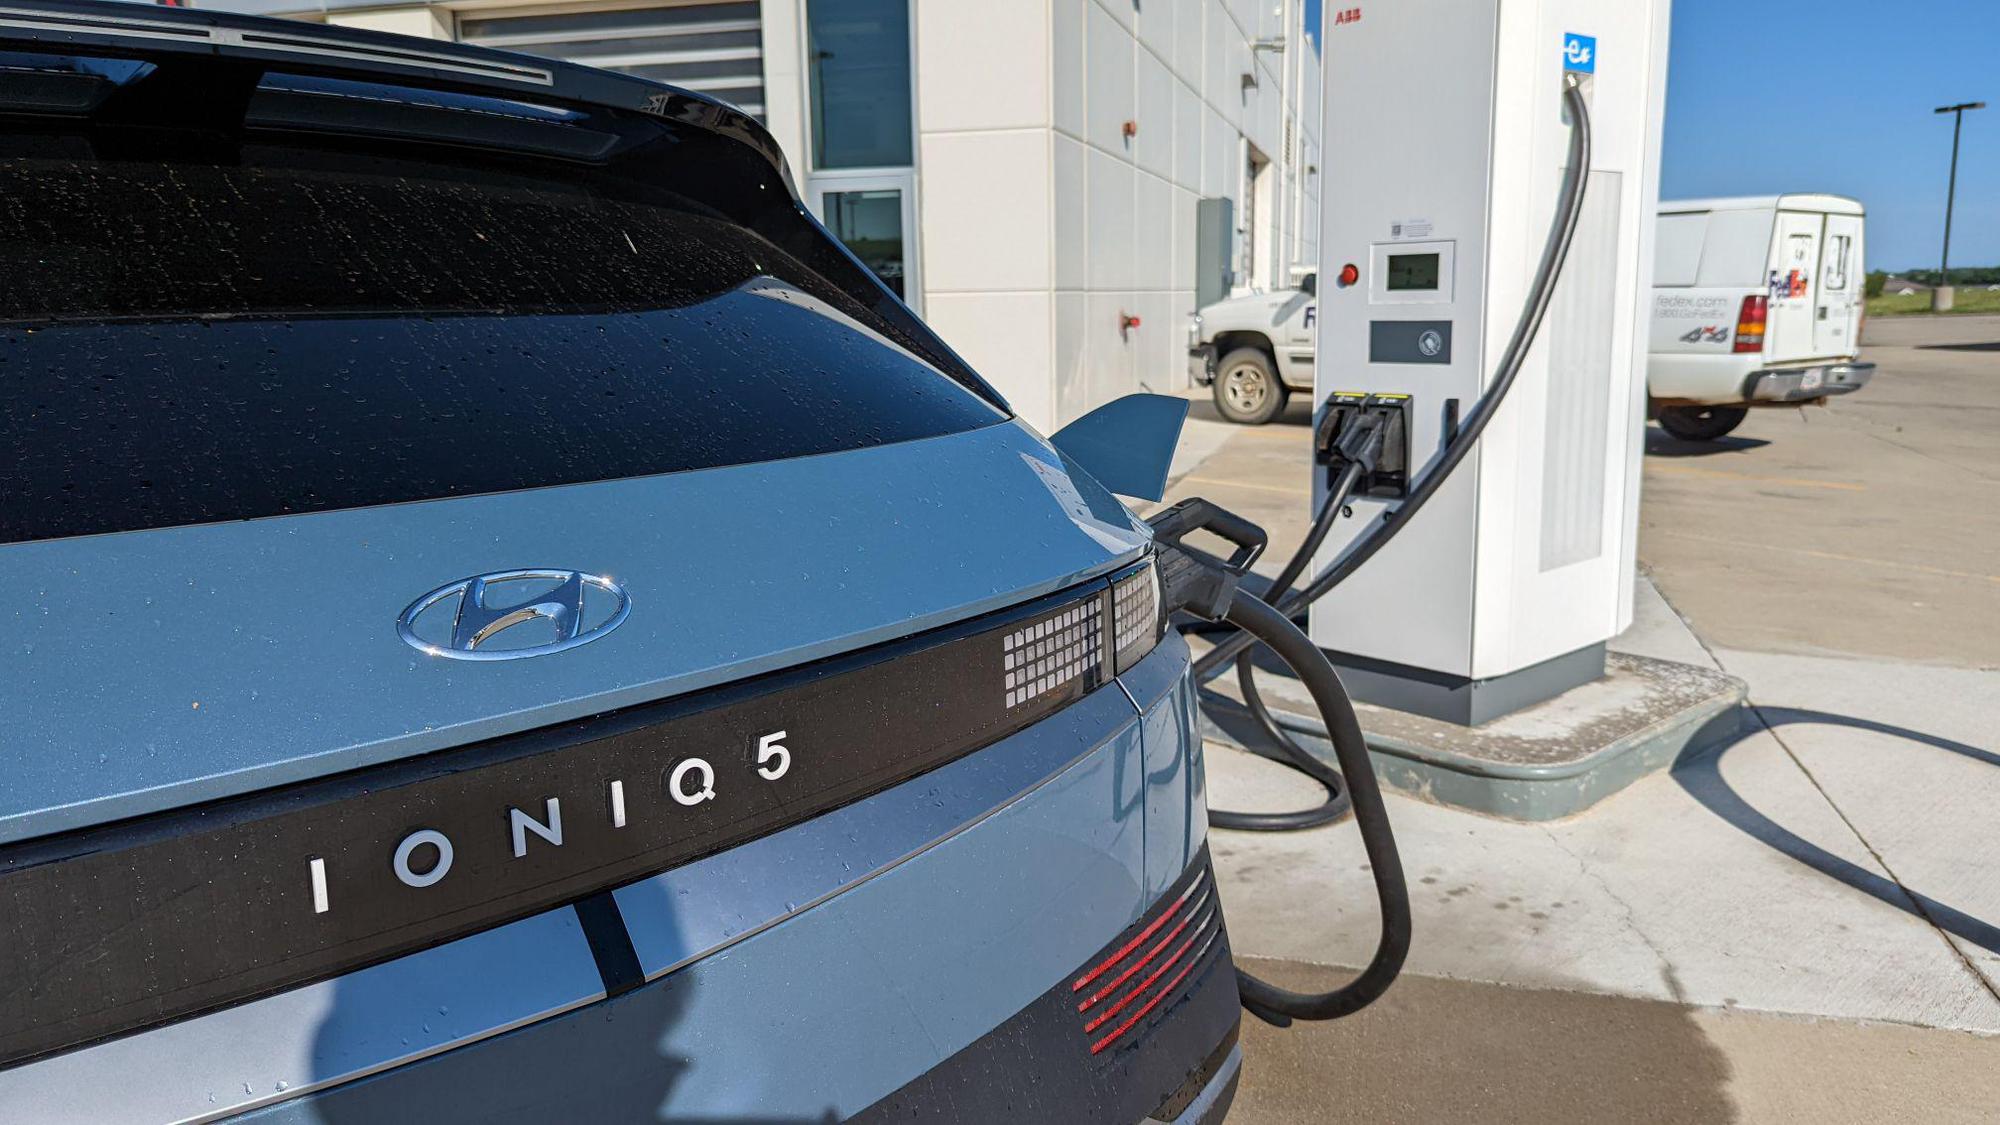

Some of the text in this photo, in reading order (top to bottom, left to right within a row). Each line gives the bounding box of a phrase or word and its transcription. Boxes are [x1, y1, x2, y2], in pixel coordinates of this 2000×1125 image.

[1335, 8, 1360, 25] ABB
[1769, 269, 1807, 298] FedEx
[1656, 295, 1728, 307] fedex.com
[310, 730, 792, 914] IONIQ 5
